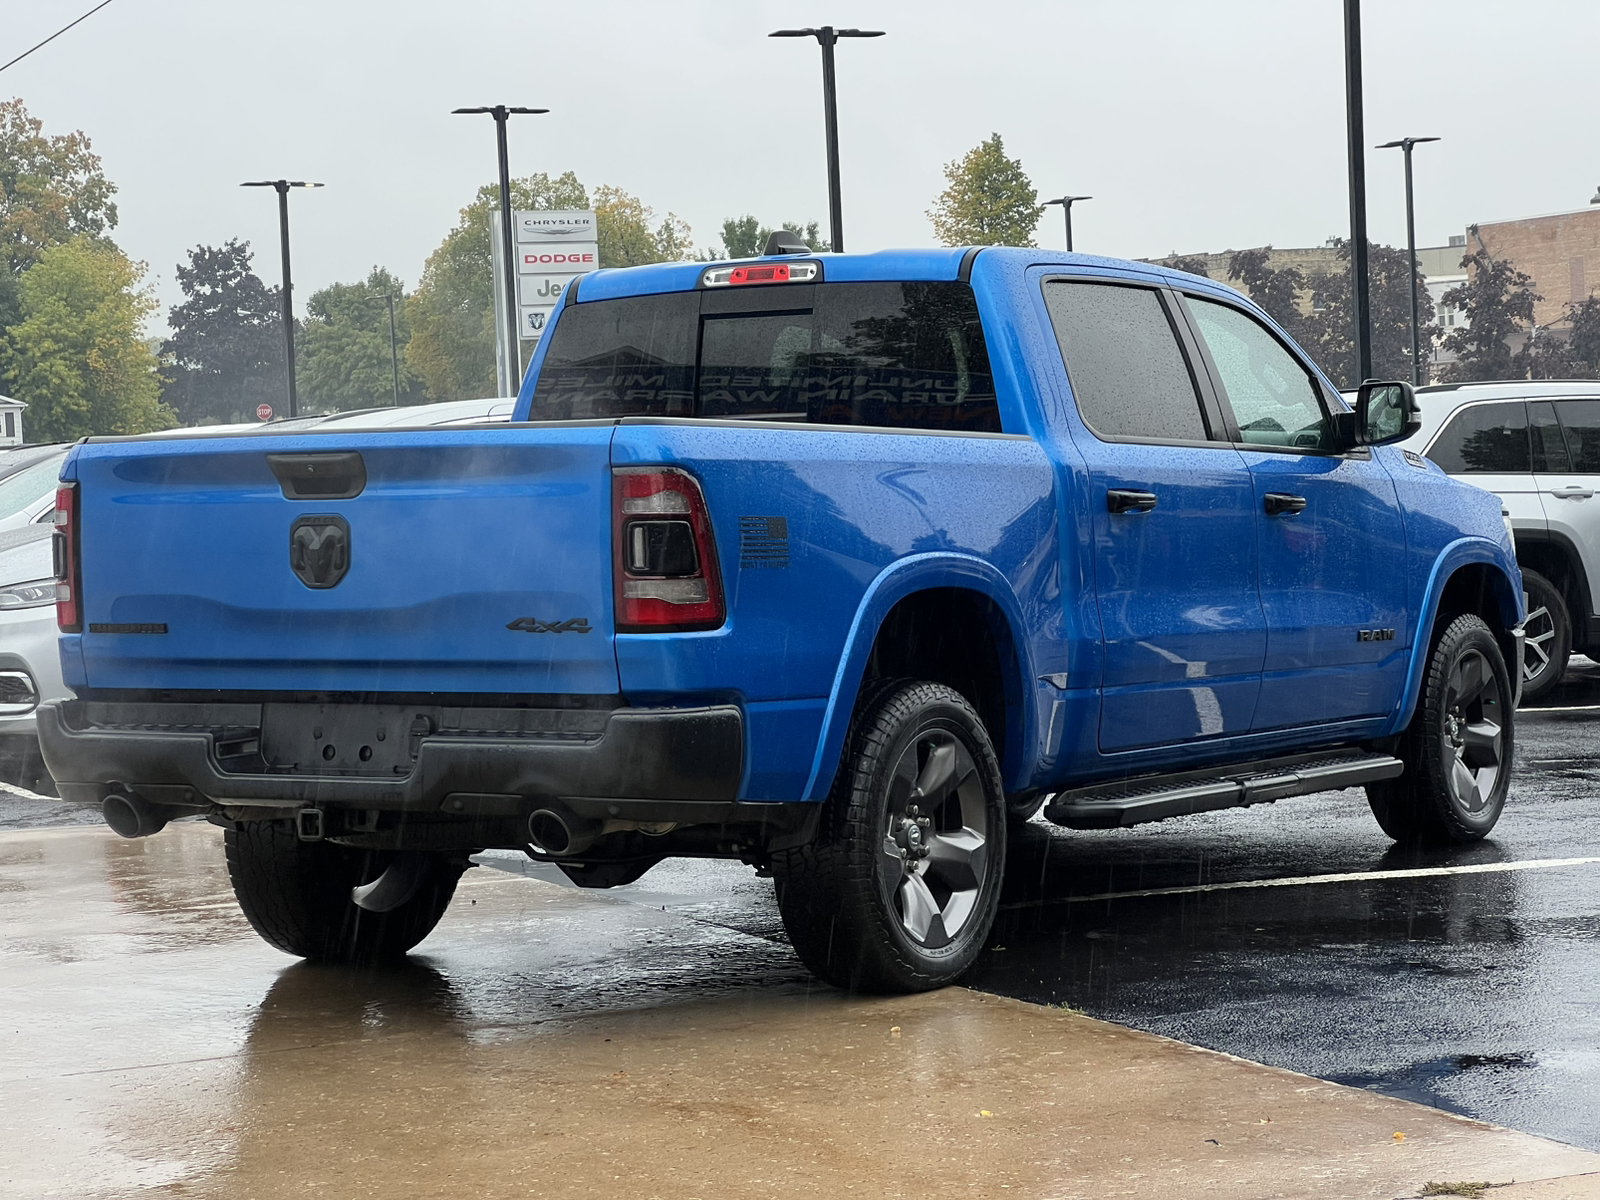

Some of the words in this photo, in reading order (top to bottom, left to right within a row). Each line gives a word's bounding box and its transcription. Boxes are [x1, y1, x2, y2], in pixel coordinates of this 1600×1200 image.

[525, 254, 593, 263] DODGE
[537, 280, 565, 297] Je
[1357, 628, 1395, 642] RAM
